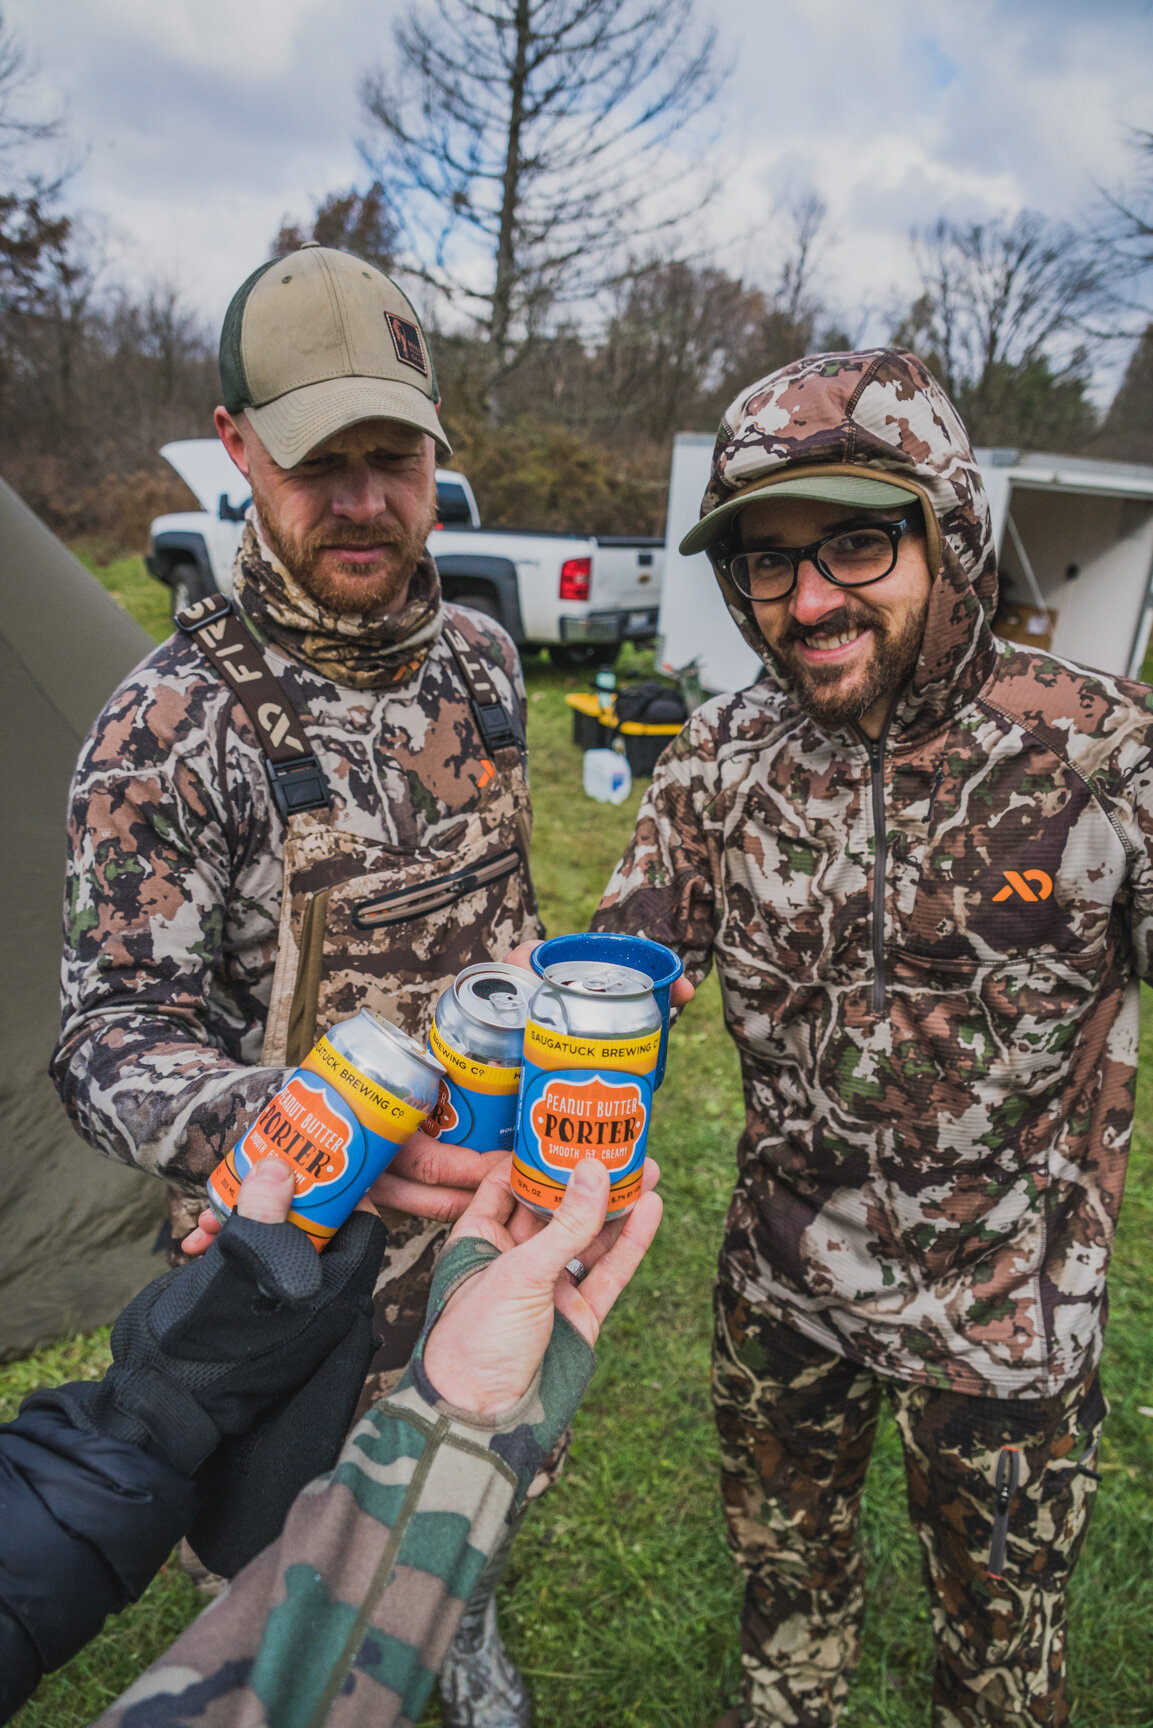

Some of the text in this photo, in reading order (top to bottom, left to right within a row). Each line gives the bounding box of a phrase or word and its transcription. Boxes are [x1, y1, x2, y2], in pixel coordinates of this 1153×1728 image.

[445, 628, 497, 703] ITE
[531, 1030, 595, 1057] SAUGATUCK
[602, 1043, 651, 1058] BREWING
[340, 1069, 390, 1110] BREWING
[546, 1093, 638, 1117] PEANUT BUTTER
[278, 1087, 344, 1153] PEANUT BUTTER
[544, 1113, 636, 1145] PORTER
[259, 1104, 331, 1179] PORTER
[548, 1143, 579, 1159] SMOOTH
[601, 1146, 628, 1160] CREAMY
